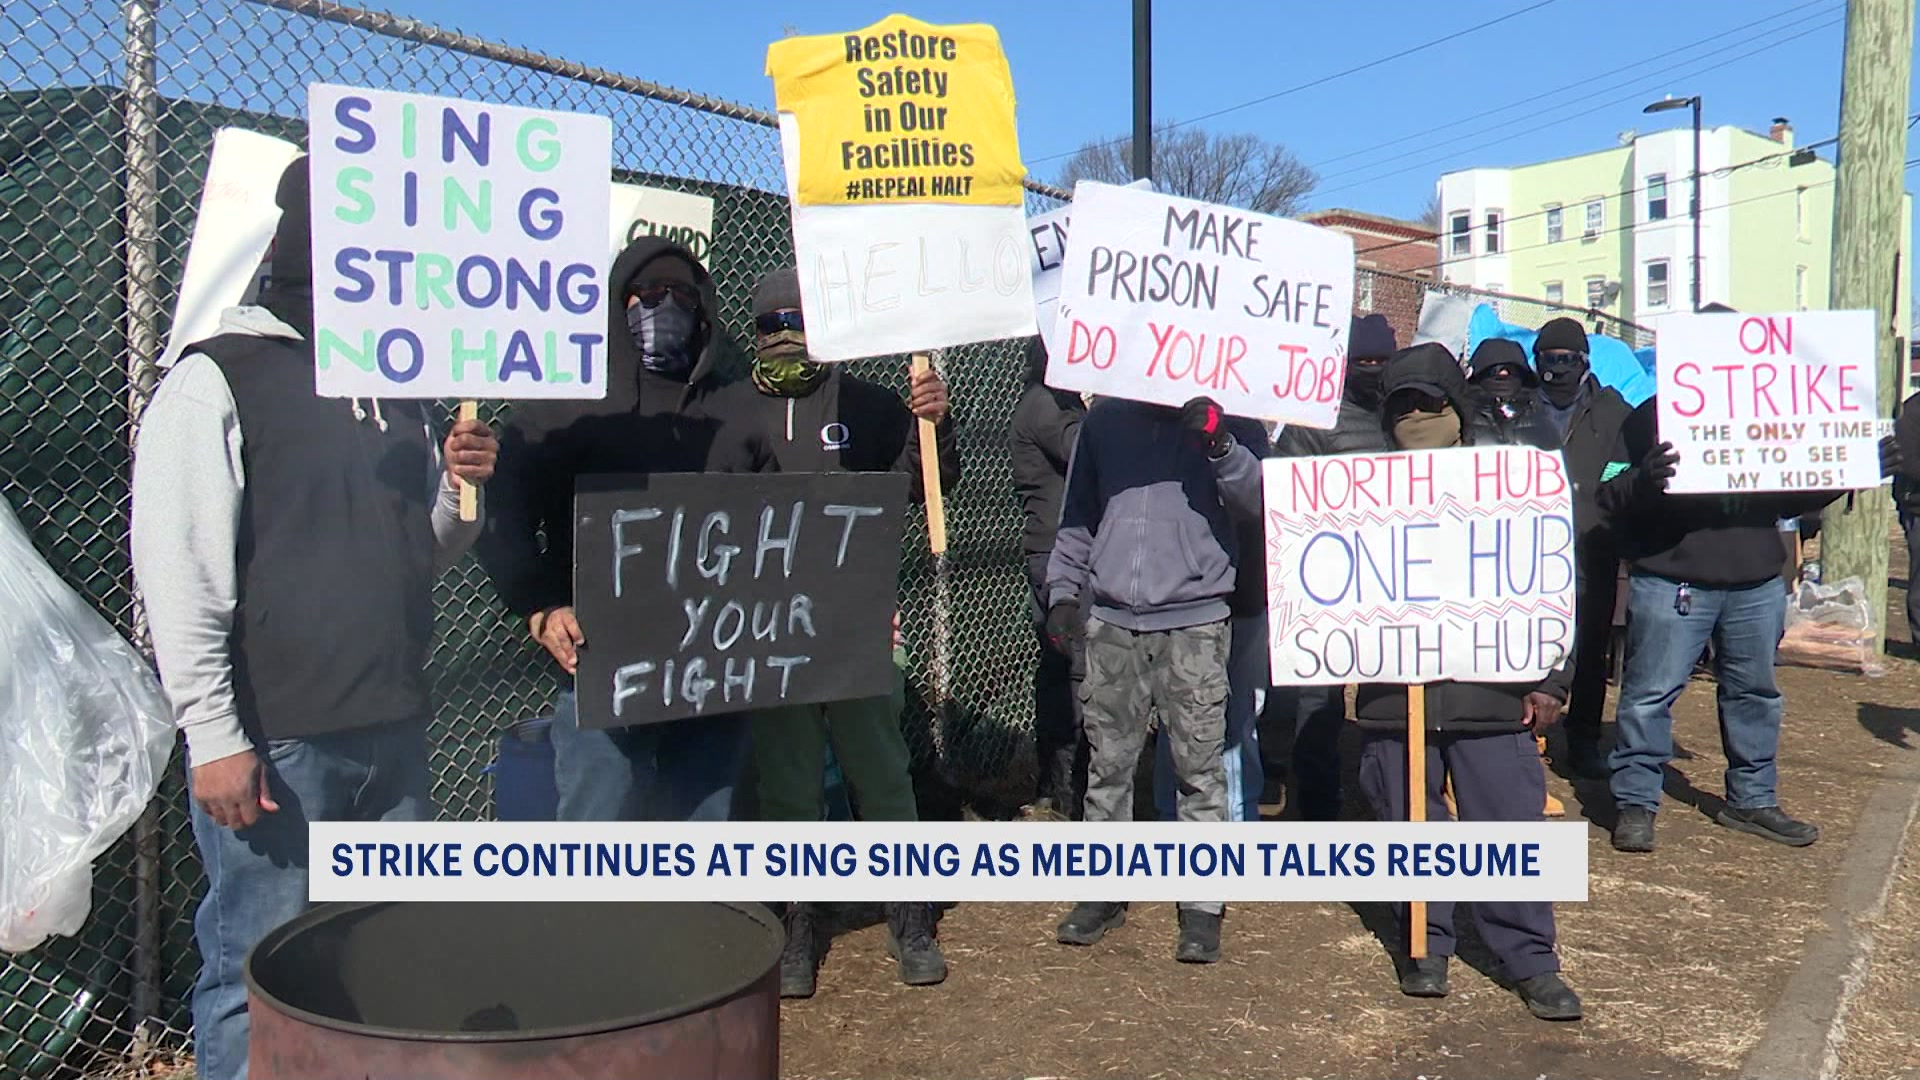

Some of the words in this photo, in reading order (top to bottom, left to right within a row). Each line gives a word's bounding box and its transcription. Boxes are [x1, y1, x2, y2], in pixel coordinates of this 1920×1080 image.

[844, 29, 957, 63] Restore
[857, 66, 947, 98] Safety
[334, 96, 562, 173] SING
[864, 104, 892, 133] in
[899, 101, 947, 132] Our
[841, 138, 975, 170] Facilities
[334, 167, 563, 241] SING
[846, 176, 927, 200] #REPEAL
[931, 175, 973, 197] HALT
[1163, 206, 1263, 262] MAKE
[334, 247, 600, 314] STRONG
[814, 235, 1022, 333] HELLO
[1088, 246, 1219, 310] PRISON
[1243, 274, 1342, 339] SAFE,
[318, 328, 424, 384] NO
[451, 329, 604, 384] HALT
[1146, 322, 1250, 394] YOUR
[1739, 316, 1793, 355] ON
[1671, 362, 1860, 419] STRIKE
[1688, 424, 1731, 441] THE
[1746, 422, 1806, 440] ONLY
[1819, 421, 1873, 438] TIME
[1702, 448, 1745, 465] GET
[1757, 447, 1787, 464] TO
[1808, 446, 1848, 463] SEE
[1291, 453, 1434, 512] NORTH
[1474, 449, 1566, 502] HUB
[1727, 472, 1761, 489] MY
[1780, 469, 1845, 487] KIDS!
[611, 501, 884, 597] FIGHT
[1299, 523, 1440, 606] ONE
[1469, 515, 1573, 598] HUB
[679, 594, 816, 651] YOUR
[1294, 623, 1442, 678] SOUTH
[1474, 617, 1567, 673] HUB
[613, 656, 811, 716] FIGHT
